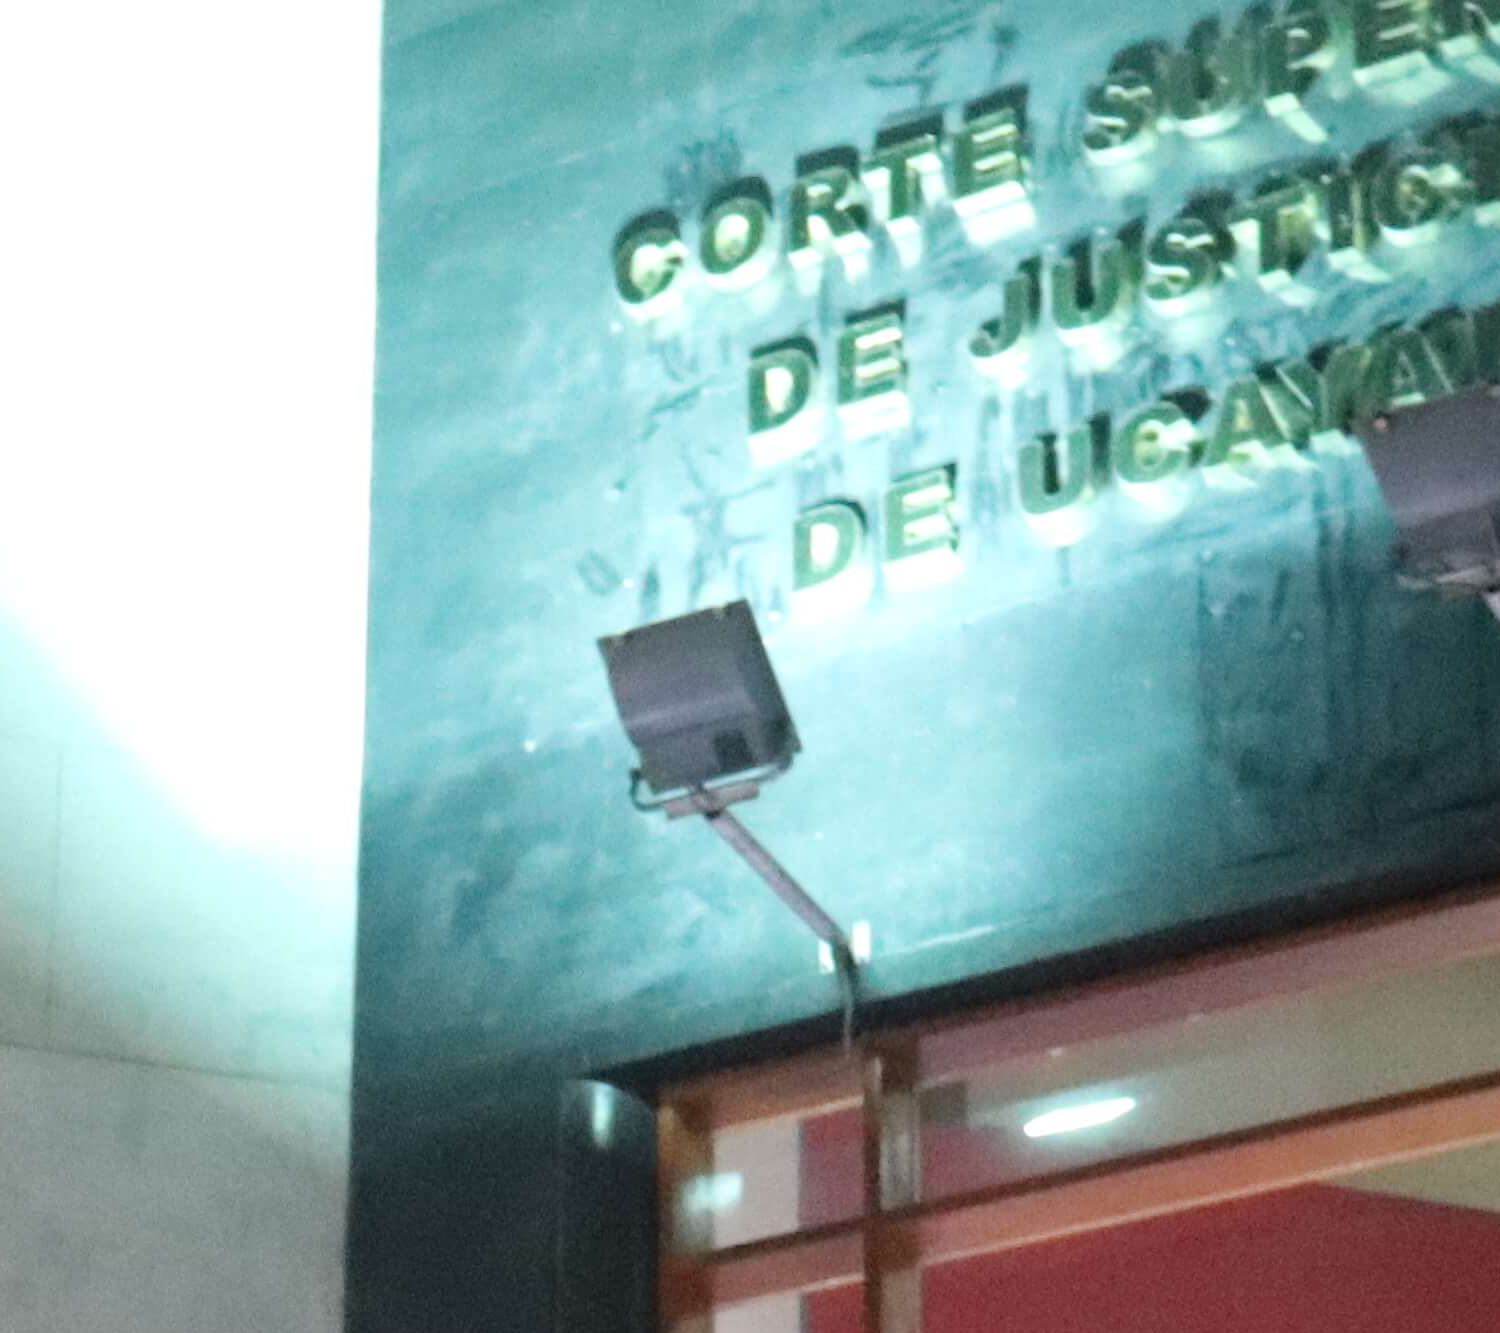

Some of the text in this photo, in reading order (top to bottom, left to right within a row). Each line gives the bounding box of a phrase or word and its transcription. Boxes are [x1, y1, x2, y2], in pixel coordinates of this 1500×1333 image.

[612, 88, 1028, 305] CORTE
[748, 302, 906, 433] DE
[793, 465, 957, 591] DE
